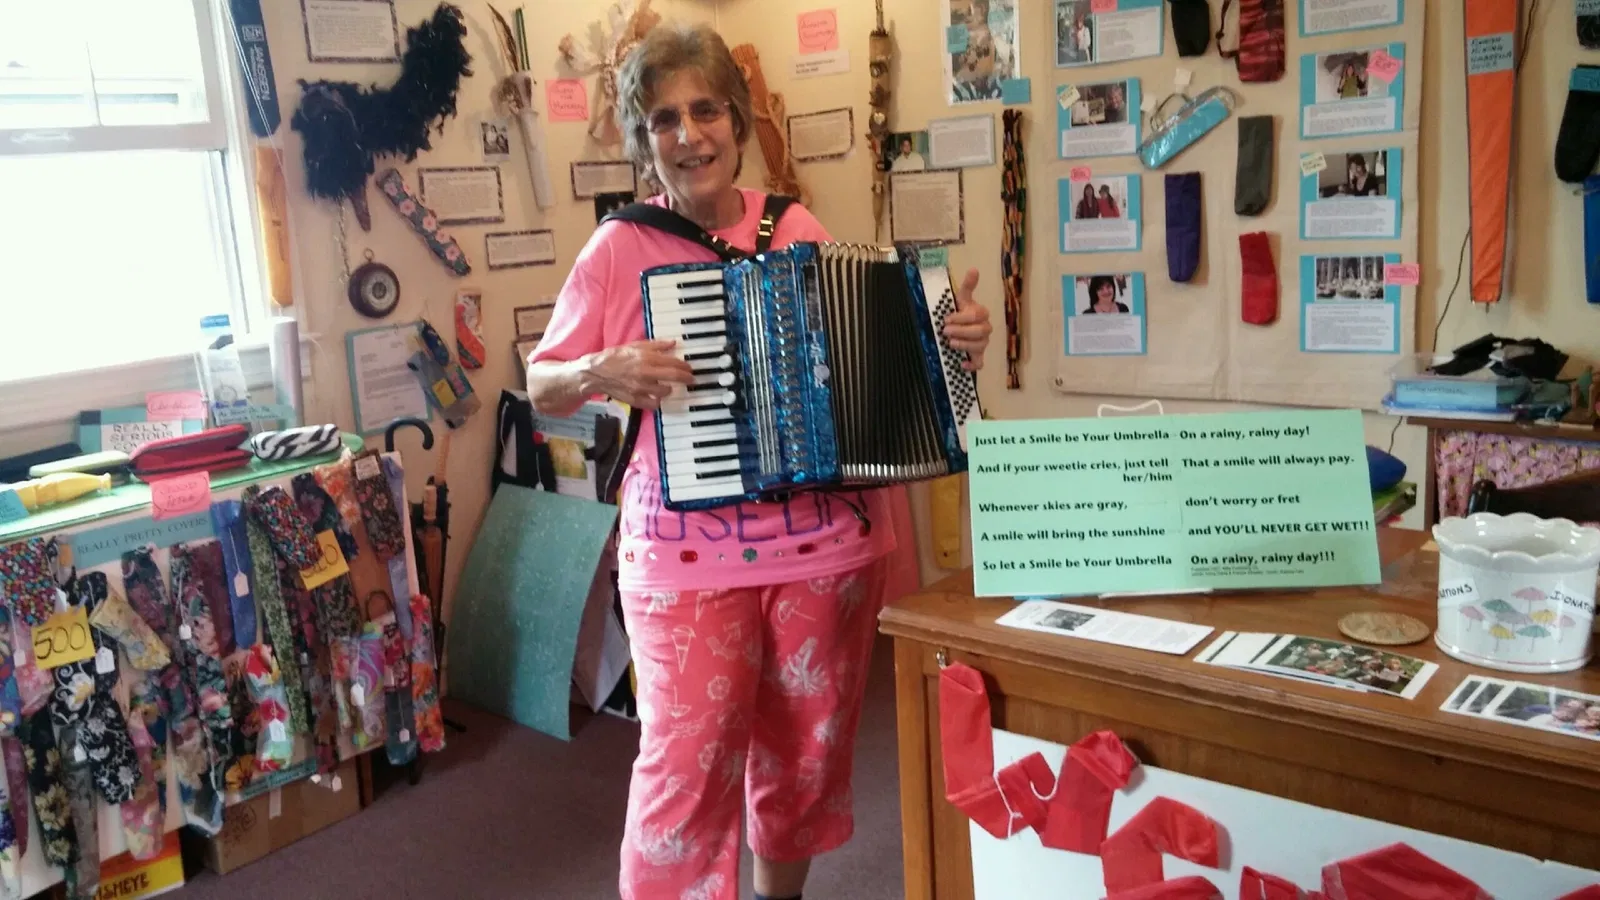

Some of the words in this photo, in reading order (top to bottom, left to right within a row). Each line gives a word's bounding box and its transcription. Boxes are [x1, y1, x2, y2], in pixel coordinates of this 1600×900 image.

[254, 42, 271, 101] JANSSEN
[113, 422, 168, 433] REALLY
[1180, 430, 1197, 440] On
[1210, 428, 1246, 441] rainy,
[1249, 427, 1280, 439] rainy
[1283, 425, 1310, 438] day!
[975, 435, 997, 447] Just
[1000, 435, 1016, 445] let
[1029, 432, 1062, 444] Smile
[1065, 433, 1080, 443] be
[1082, 432, 1111, 442] Your
[1113, 430, 1170, 441] Umbrella
[977, 463, 1000, 474] And
[1003, 463, 1011, 473] if
[1014, 464, 1041, 475] your
[1044, 460, 1087, 472] sweetie
[1090, 459, 1121, 471] cries,
[1124, 458, 1146, 471] just
[1149, 458, 1169, 468] tell
[1182, 458, 1210, 468] That
[1213, 459, 1220, 467] a
[1223, 456, 1255, 466] smile
[1258, 455, 1281, 465] will
[1284, 455, 1325, 466] always
[1328, 455, 1354, 465] pay.
[1122, 472, 1173, 483] her/him
[979, 501, 1040, 513] Whenever
[1043, 500, 1071, 511] skies
[1074, 501, 1094, 510] are
[1097, 500, 1128, 512] gray,
[1185, 495, 1218, 507] don't
[1221, 497, 1257, 507] worry
[1277, 494, 1301, 504] fret
[77, 537, 121, 555] REALLY
[124, 526, 165, 544] PRETTY
[167, 517, 209, 534] COVERS
[981, 532, 990, 542] A
[993, 530, 1024, 541] smile
[1026, 529, 1049, 540] will
[1052, 528, 1085, 541] bring
[1088, 527, 1109, 538] the
[1111, 525, 1166, 537] sunshine
[1188, 525, 1212, 536] and
[1214, 524, 1258, 535] YOU'LL
[1261, 522, 1302, 534] NEVER
[1305, 521, 1329, 532] GET
[1331, 520, 1370, 531] WET!!
[983, 560, 997, 571] So
[1000, 560, 1016, 570] let
[1029, 558, 1062, 569] Smile
[1065, 558, 1080, 568] be
[1083, 557, 1112, 567] Your
[1115, 555, 1172, 567] Umbrella
[1191, 555, 1208, 565] On
[1212, 556, 1219, 564] a
[1222, 553, 1258, 566] rainy,
[1261, 551, 1294, 564] rainy
[1297, 550, 1335, 564] day!!!
[34, 622, 87, 660] 500
